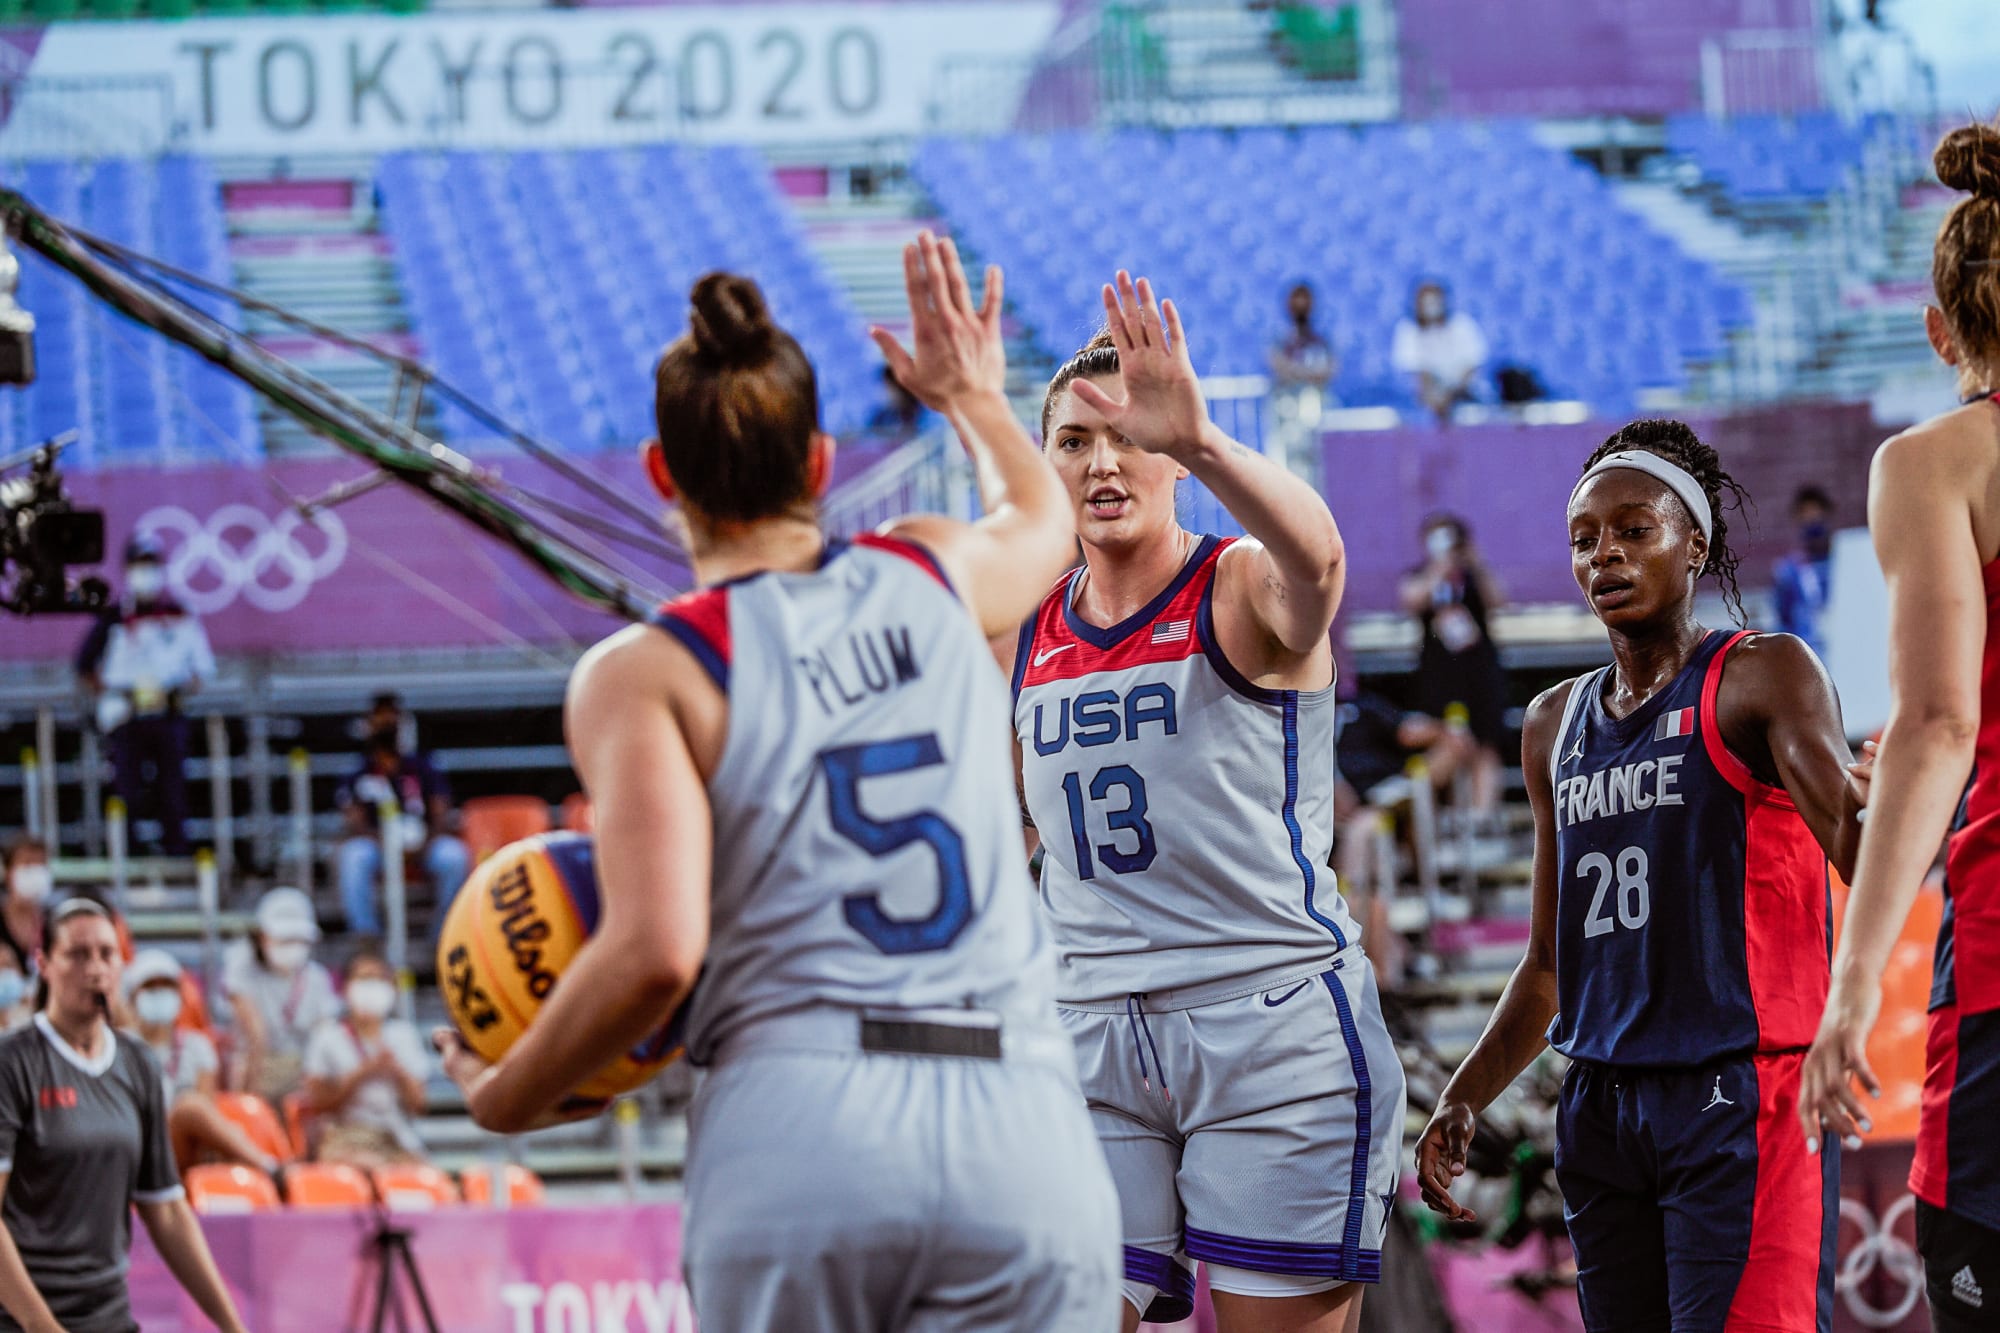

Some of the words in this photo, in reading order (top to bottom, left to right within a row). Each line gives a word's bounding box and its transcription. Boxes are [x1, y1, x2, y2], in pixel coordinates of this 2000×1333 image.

[181, 37, 563, 131] TOKYO
[607, 29, 882, 121] 2020
[1034, 682, 1178, 757] USA
[818, 731, 976, 956] 5
[1061, 764, 1158, 881] 13
[1557, 754, 1686, 832] FRANCE
[490, 863, 557, 999] Wilso
[1576, 845, 1651, 939] 28
